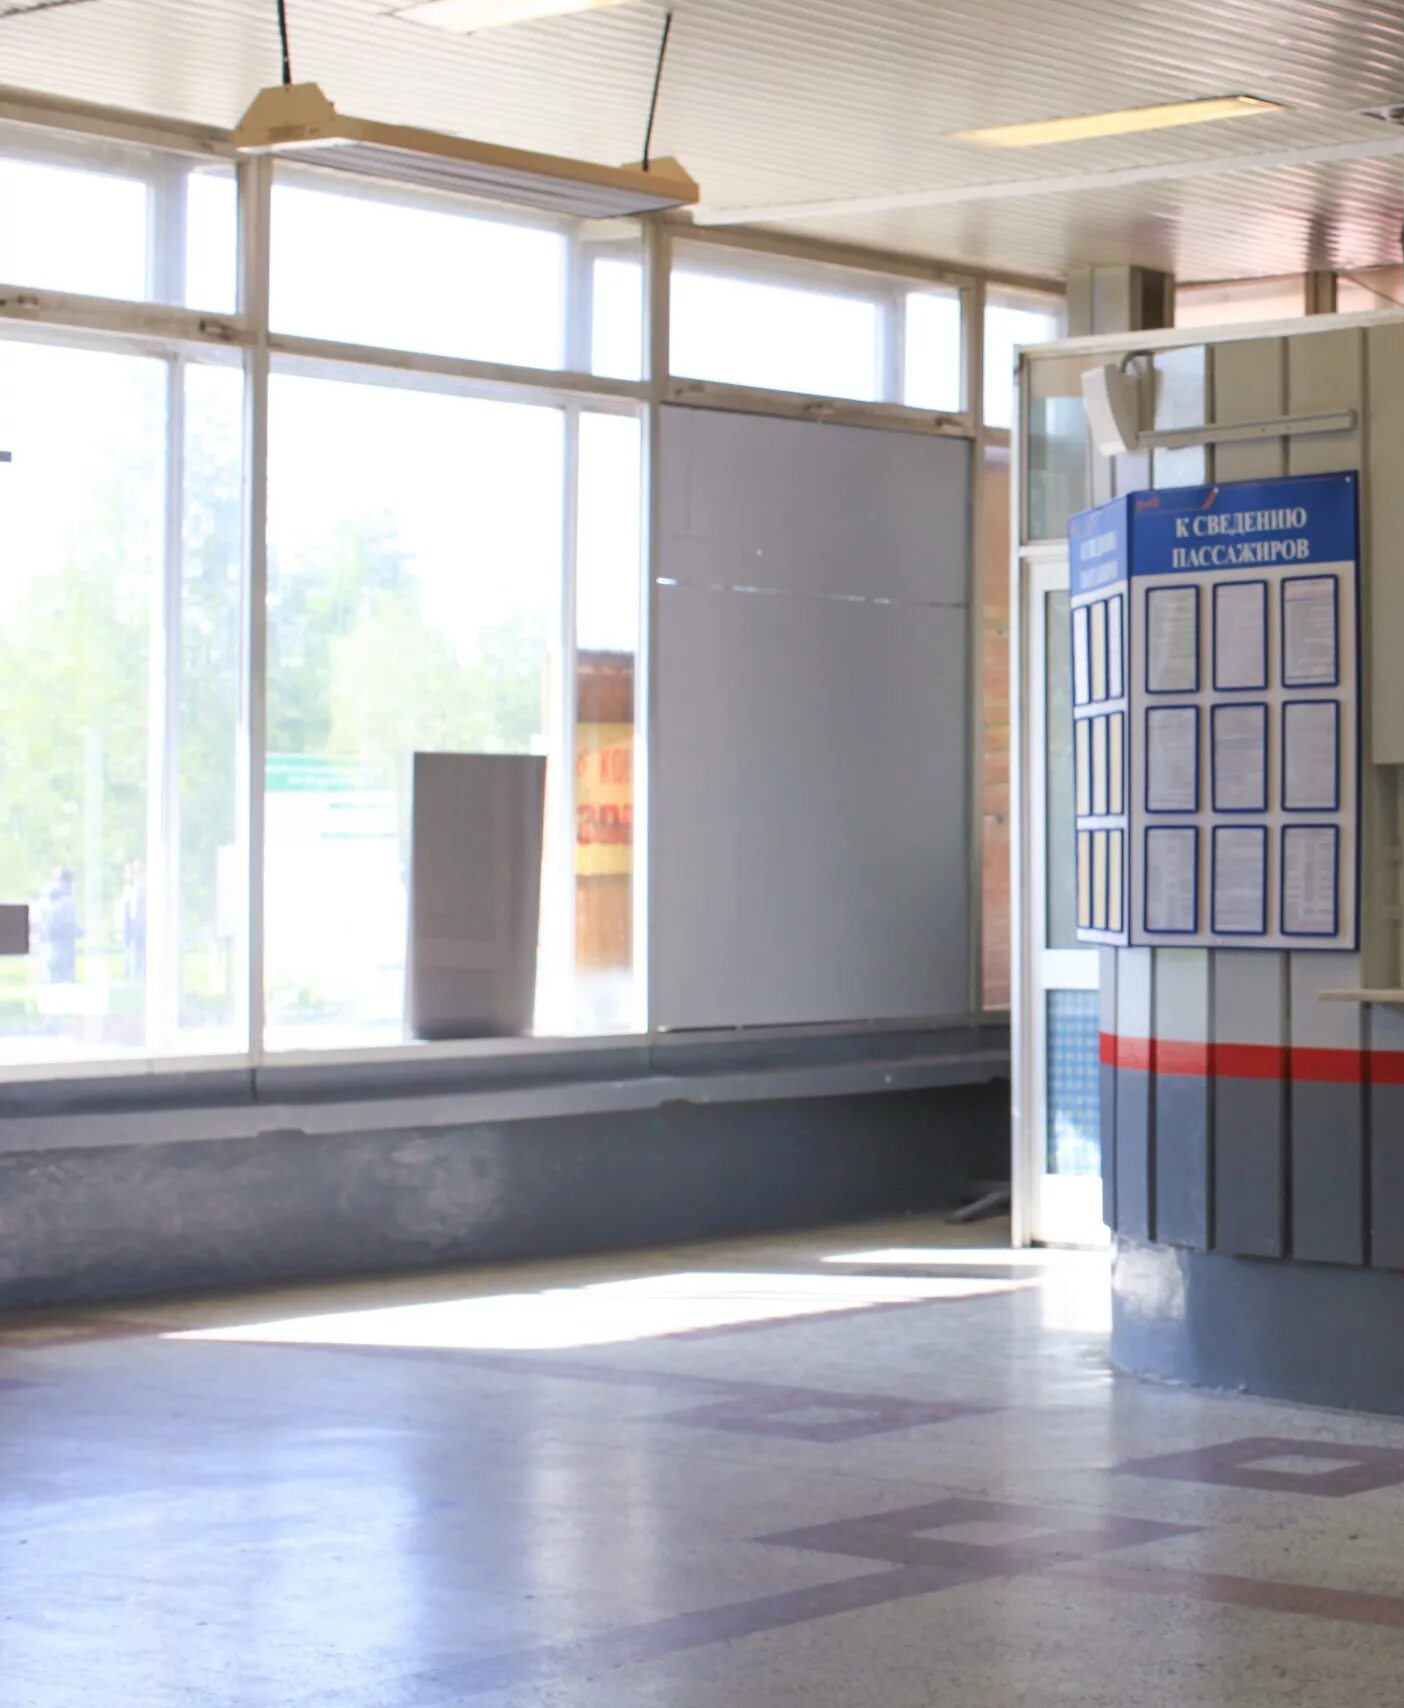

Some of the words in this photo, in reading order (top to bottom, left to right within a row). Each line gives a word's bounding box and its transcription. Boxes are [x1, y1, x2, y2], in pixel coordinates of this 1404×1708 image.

[1175, 516, 1190, 538] К
[1193, 506, 1308, 537] СВЕДЕНИЮ
[1172, 538, 1309, 568] ПАССАЖИРОВ
